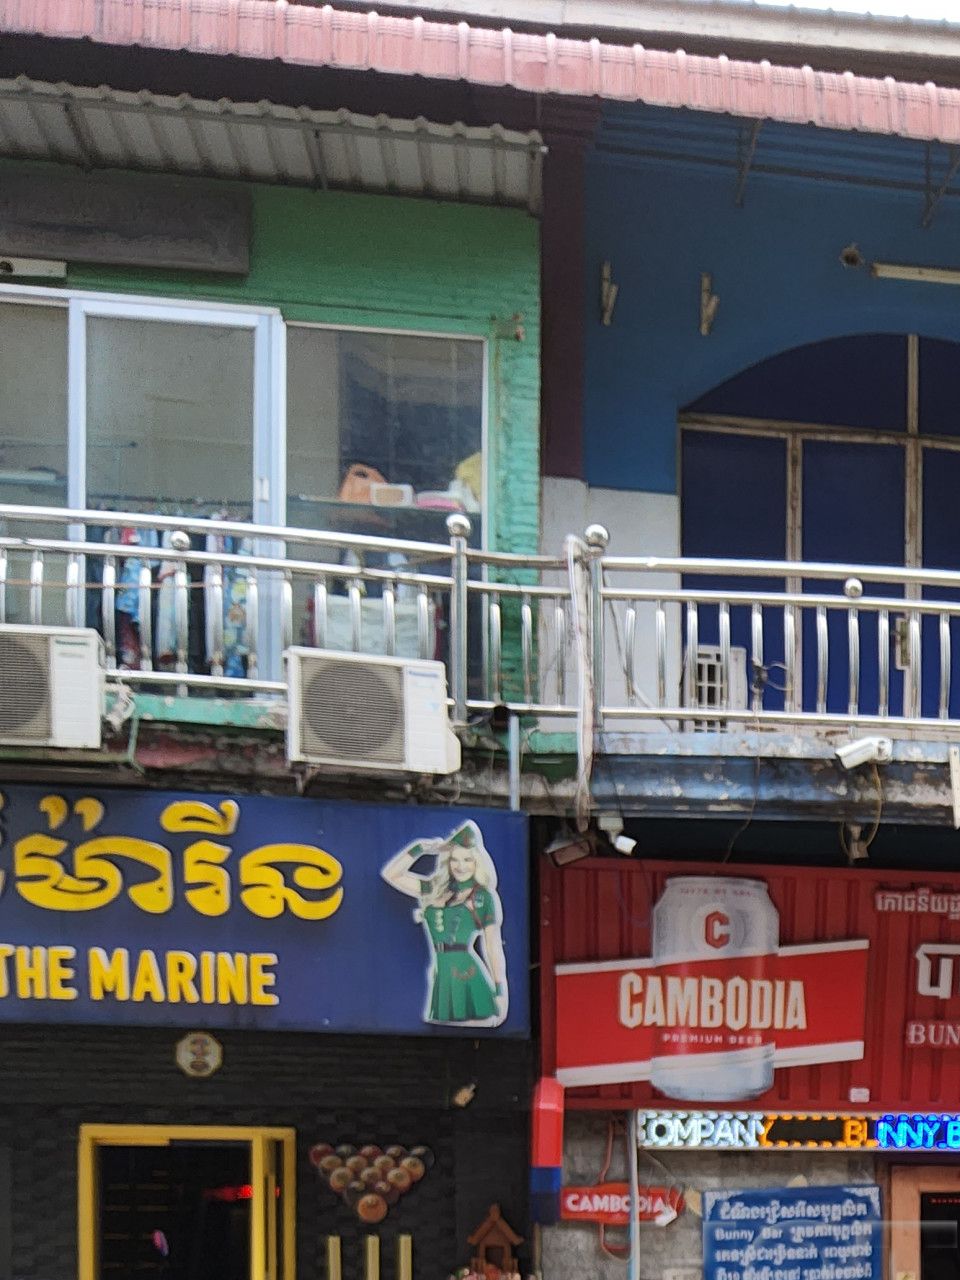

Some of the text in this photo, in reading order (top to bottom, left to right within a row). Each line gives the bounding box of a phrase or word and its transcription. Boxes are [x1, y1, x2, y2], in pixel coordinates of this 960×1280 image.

[705, 911, 730, 949] C
[0, 944, 280, 1006] THE MARINE
[618, 971, 808, 1031] CAMBODIA
[714, 1227, 754, 1242] Bunny
